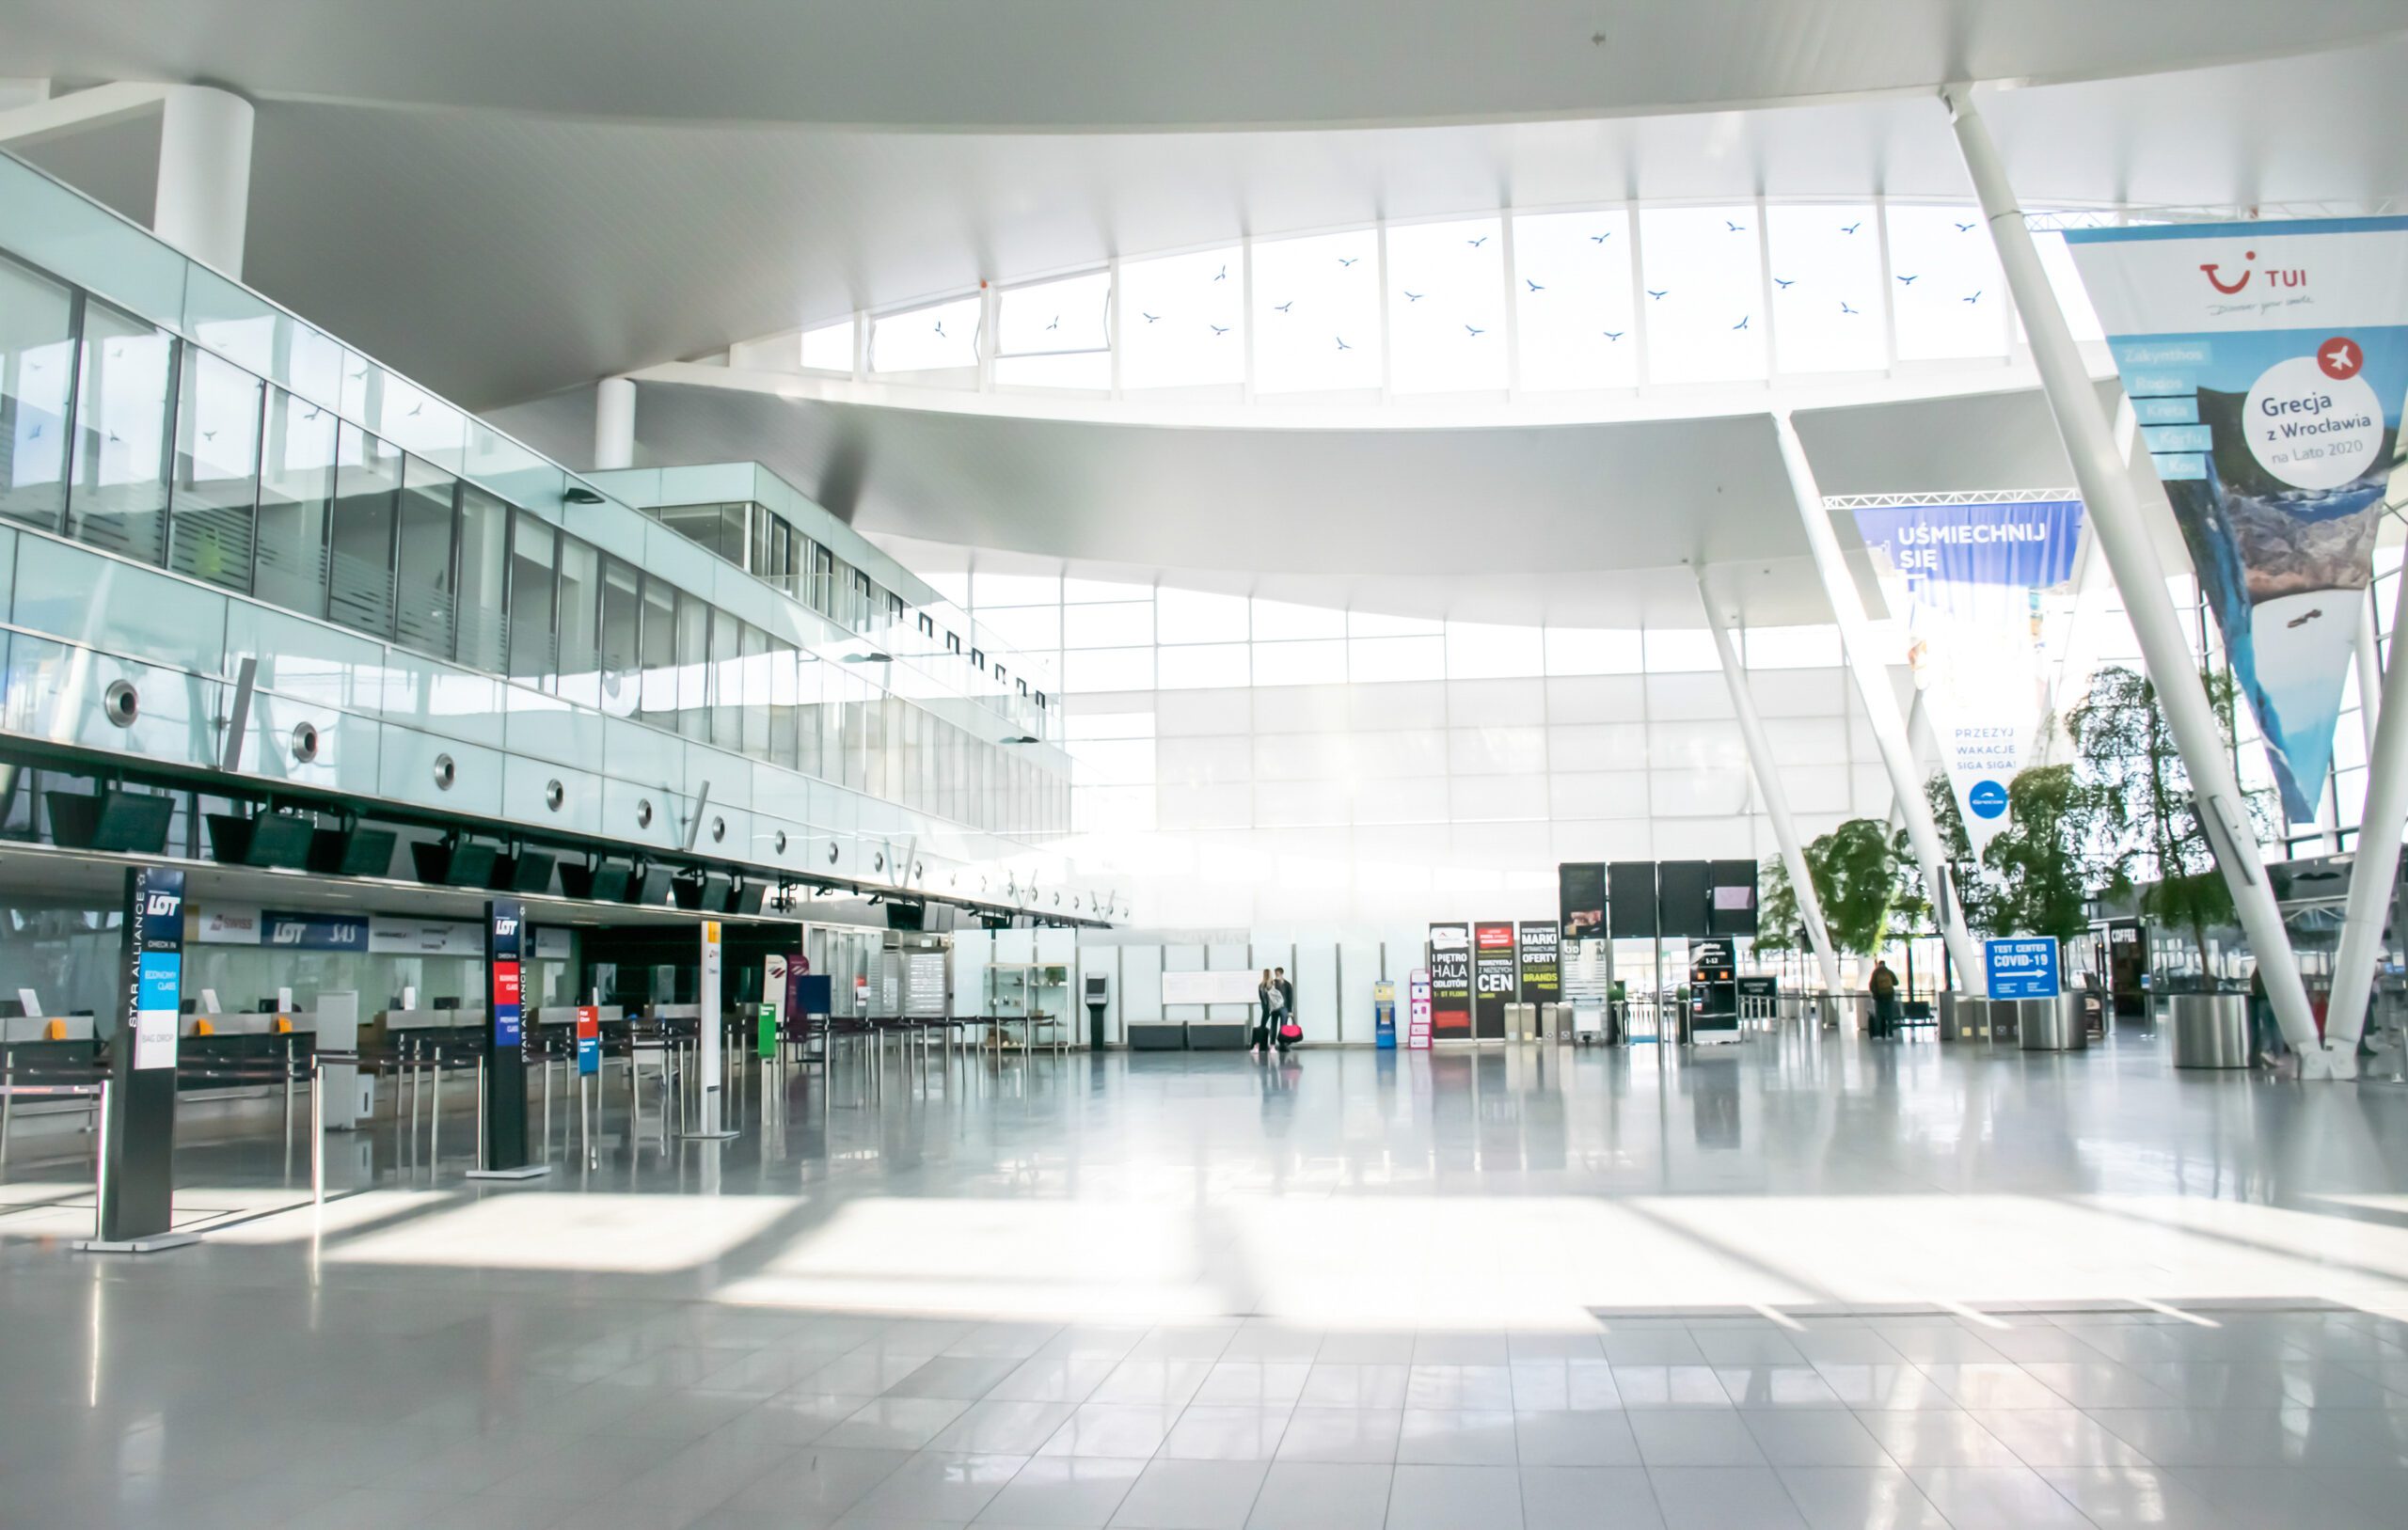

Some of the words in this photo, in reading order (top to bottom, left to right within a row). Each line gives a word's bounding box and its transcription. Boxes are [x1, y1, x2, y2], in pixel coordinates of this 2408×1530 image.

[2265, 270, 2306, 287] TUI
[2125, 348, 2204, 364] Zakynthos
[2147, 404, 2188, 417] Kreta
[2261, 391, 2333, 417] Grecja
[2267, 430, 2277, 441] z
[2280, 414, 2372, 438] Wrocławia
[2160, 432, 2203, 445] Korfu
[2272, 454, 2289, 464] na
[2292, 448, 2324, 461] Lato
[2327, 439, 2364, 456] 2020
[2168, 459, 2198, 472] Kos
[1898, 522, 2046, 545] UŚMIECHNIJ
[1899, 549, 1938, 570] SIĘ
[1956, 745, 2016, 755] WAKACJE
[1986, 760, 2017, 769] SIGA!
[147, 895, 182, 917] LOT
[132, 891, 145, 978] ALLIANCE
[272, 923, 307, 943] LOT
[329, 924, 357, 943] SAS
[495, 921, 518, 936] LOT
[2111, 928, 2137, 943] COFFEE
[148, 940, 168, 949] CHECK
[1521, 934, 1558, 945] MARKI
[1993, 945, 2013, 954] TEST
[2016, 943, 2047, 953] CENTER
[1436, 953, 1467, 965] PIĘTRO
[1522, 954, 1558, 963] OFERTY
[1994, 954, 2049, 968] COVID-19
[1433, 964, 1467, 978] HALA
[1522, 972, 1559, 983] BRANDS
[1433, 979, 1467, 988] ODLOTÓW
[1478, 973, 1513, 992] CEN
[129, 983, 139, 1028] STAR
